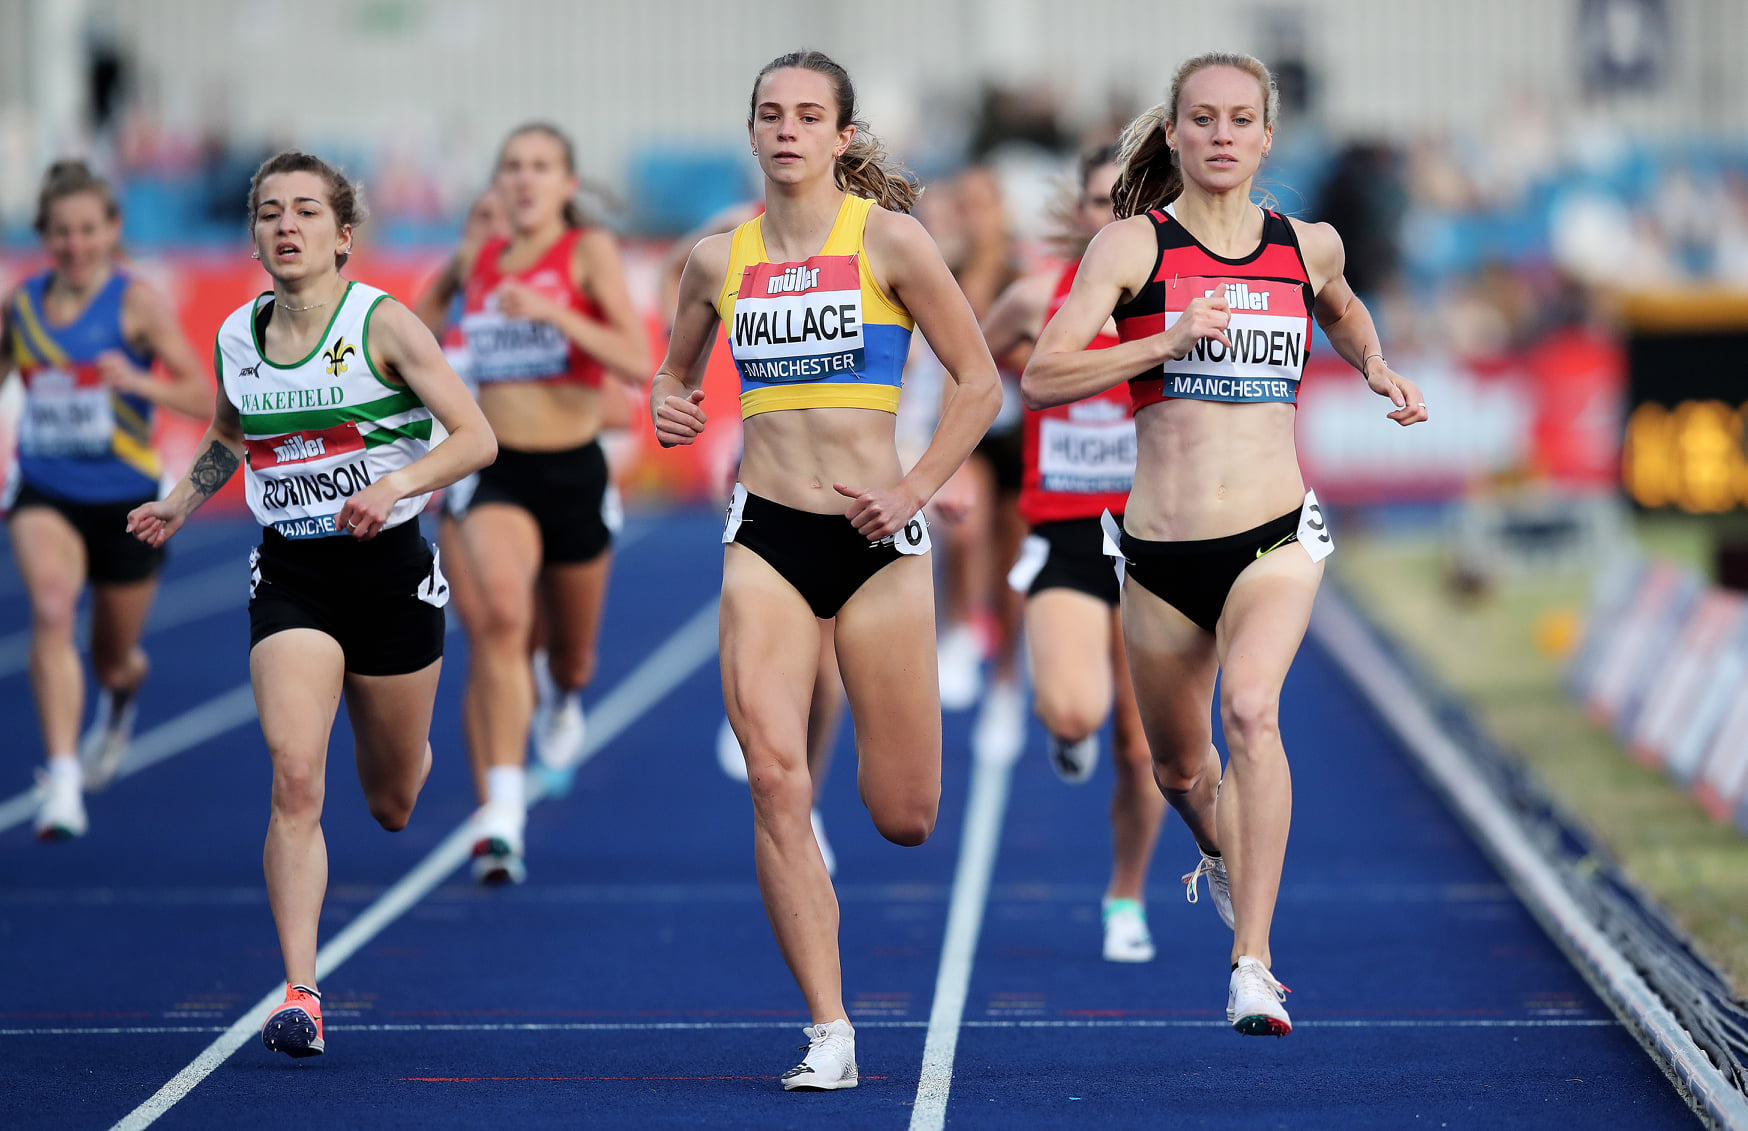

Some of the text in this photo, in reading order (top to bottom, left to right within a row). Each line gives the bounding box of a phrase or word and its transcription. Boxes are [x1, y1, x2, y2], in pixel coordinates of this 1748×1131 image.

[767, 265, 820, 294] müller
[735, 304, 858, 347] WALLACE
[745, 353, 855, 378] MANCHESTER
[241, 385, 344, 413] WAKEFIELD
[1173, 376, 1289, 398] MANCHESTER
[272, 434, 326, 464] müller
